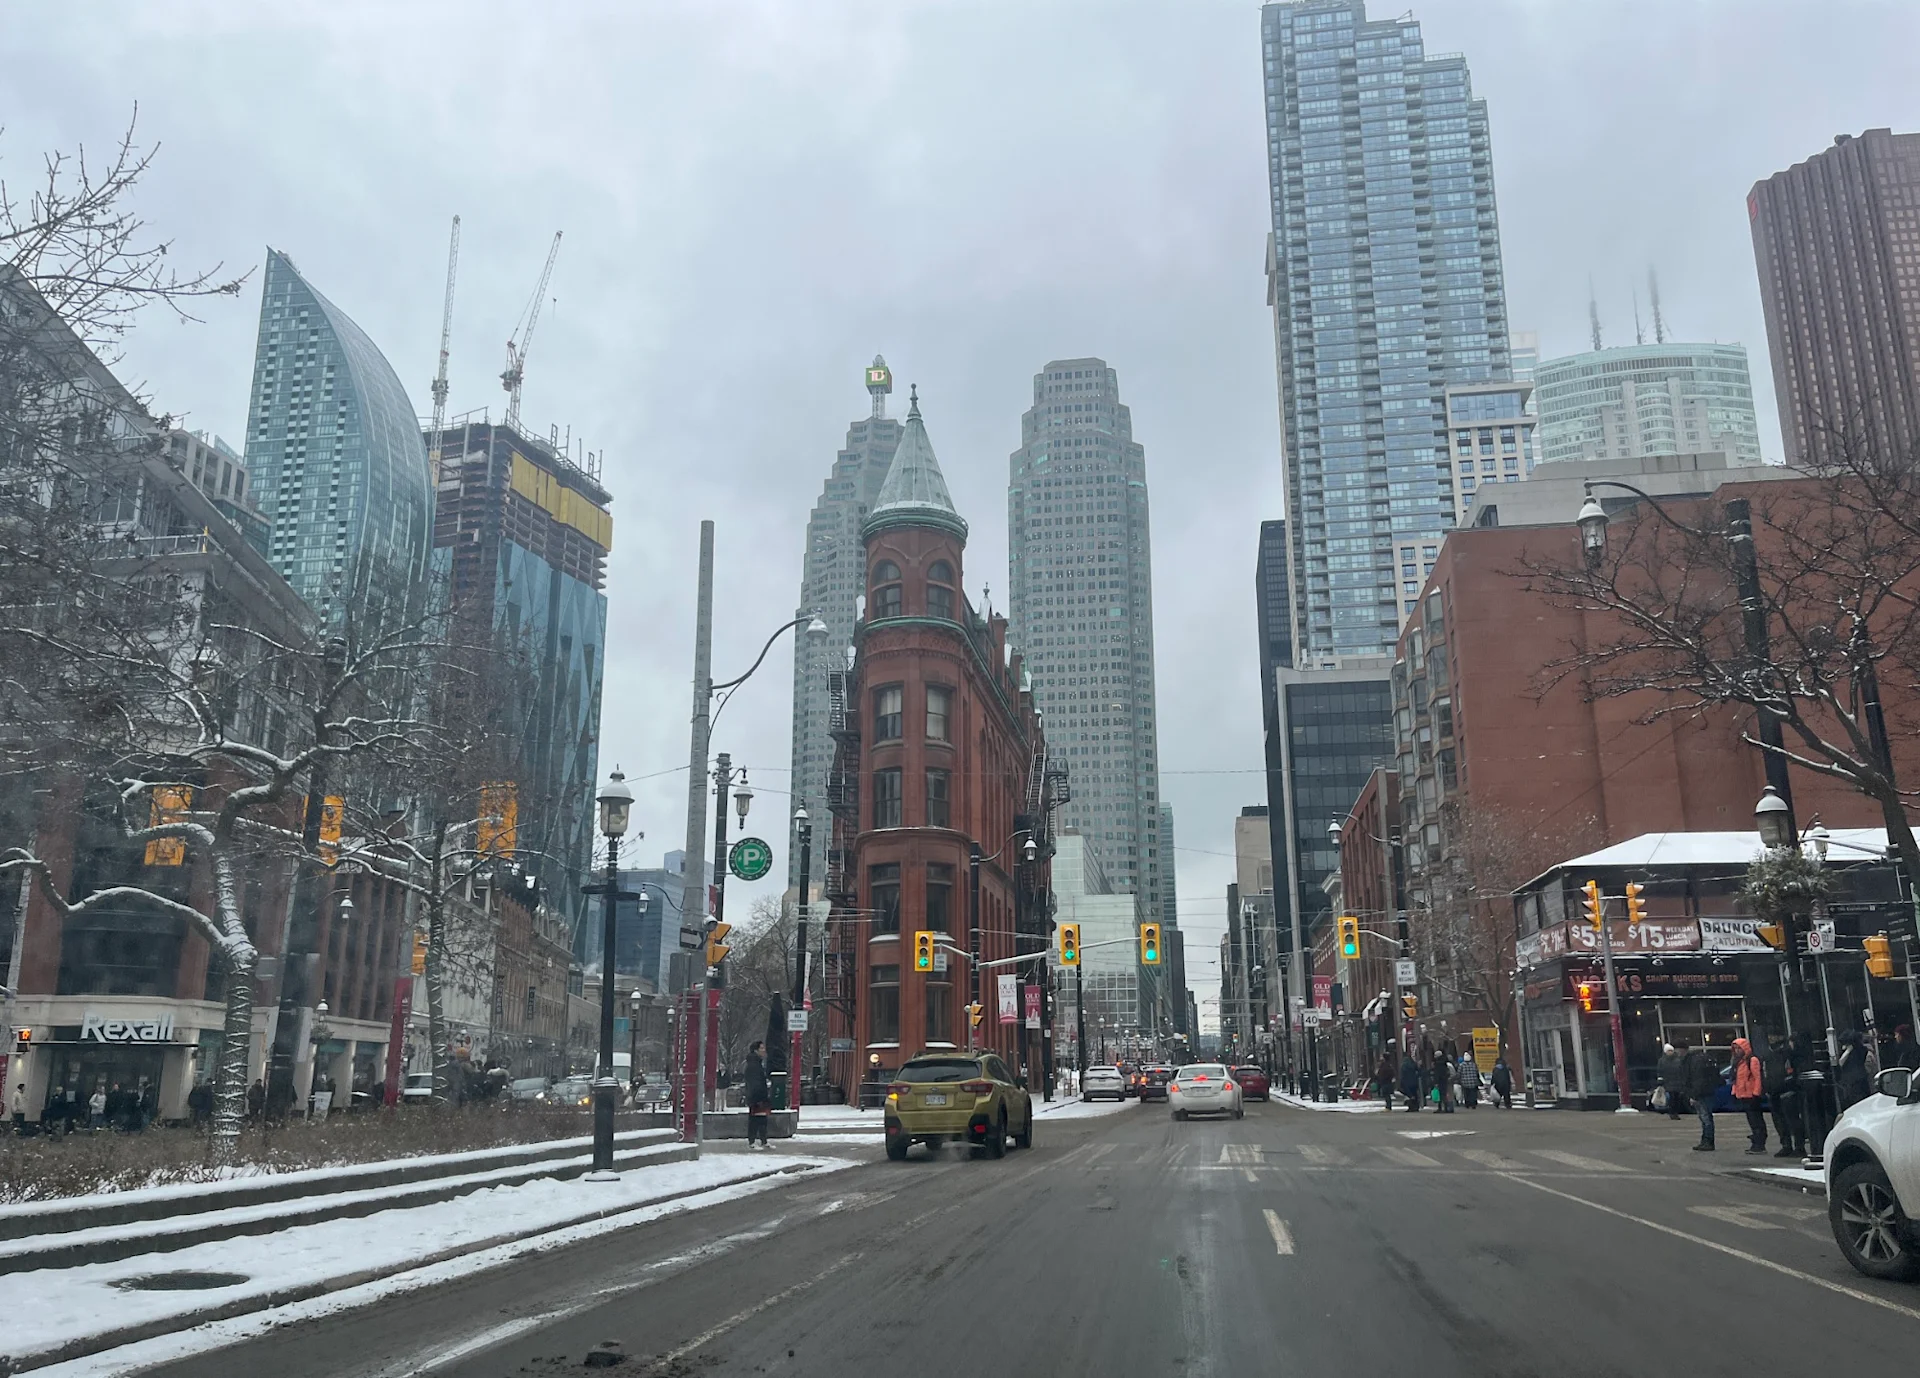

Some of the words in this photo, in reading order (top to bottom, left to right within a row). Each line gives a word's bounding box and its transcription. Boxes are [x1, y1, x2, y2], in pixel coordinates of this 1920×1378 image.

[868, 370, 885, 381] TD
[731, 839, 770, 858] MUNICIPAL
[743, 848, 760, 867] P
[731, 863, 770, 880] PARKING
[1571, 924, 1596, 948] $5
[1628, 924, 1665, 948] $15
[81, 1011, 174, 1043] Rexall
[1305, 1016, 1318, 1024] 40
